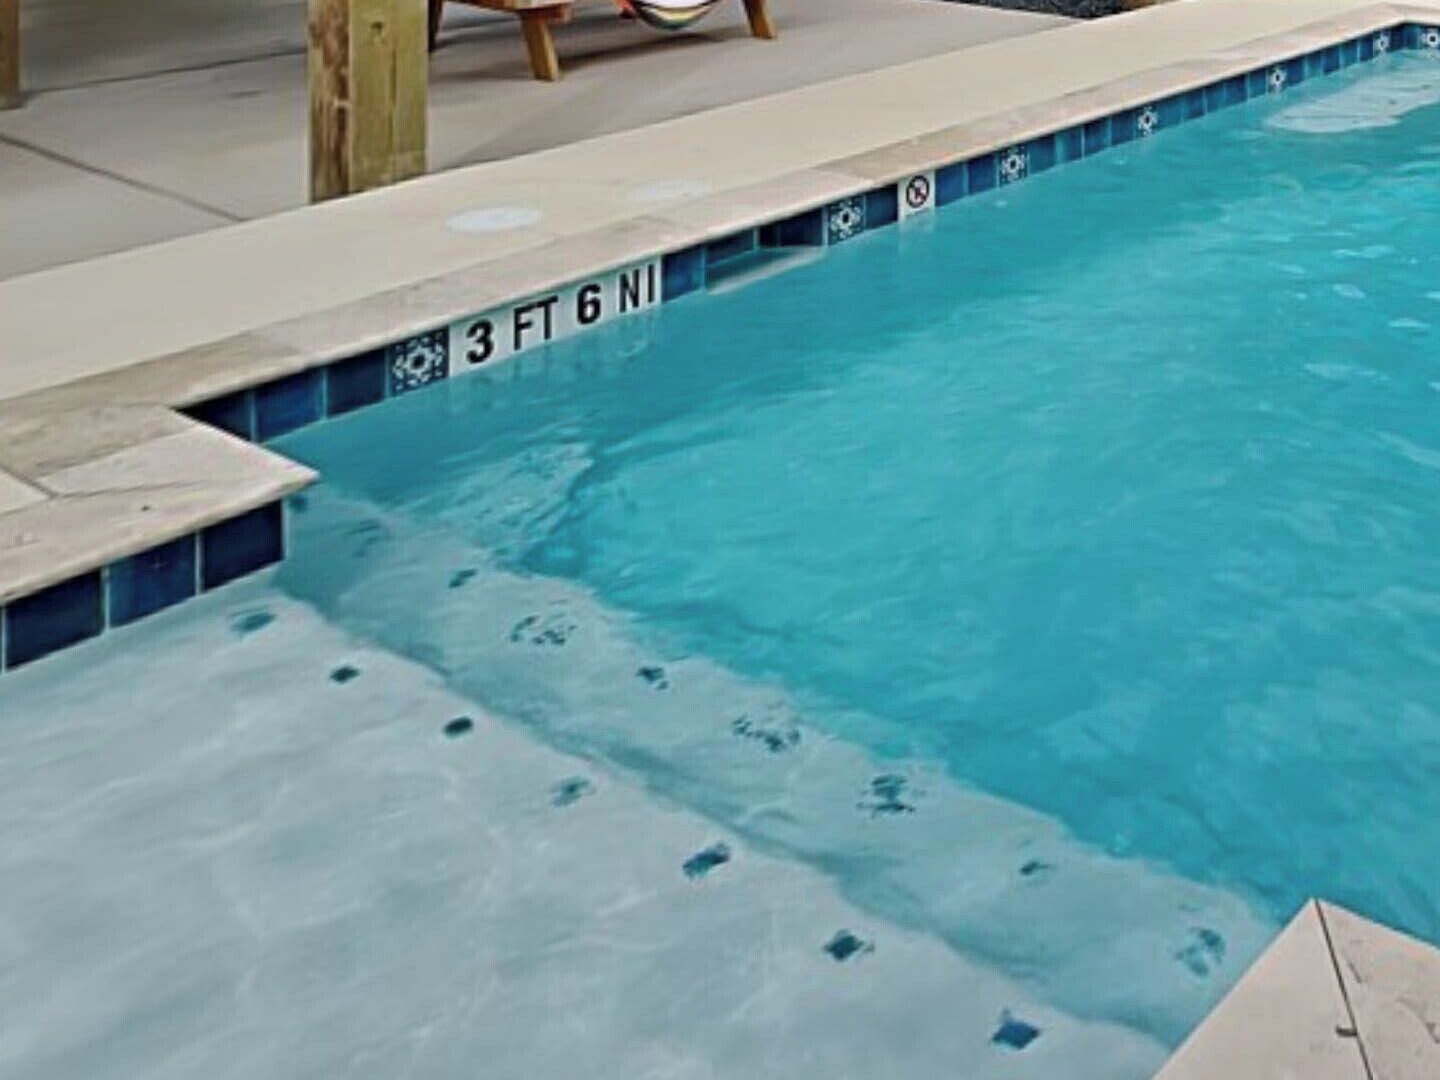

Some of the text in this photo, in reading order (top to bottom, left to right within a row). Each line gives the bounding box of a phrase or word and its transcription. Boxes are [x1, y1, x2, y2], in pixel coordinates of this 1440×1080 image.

[465, 320, 495, 364] 3
[513, 296, 559, 351] FT
[576, 283, 602, 325] 6
